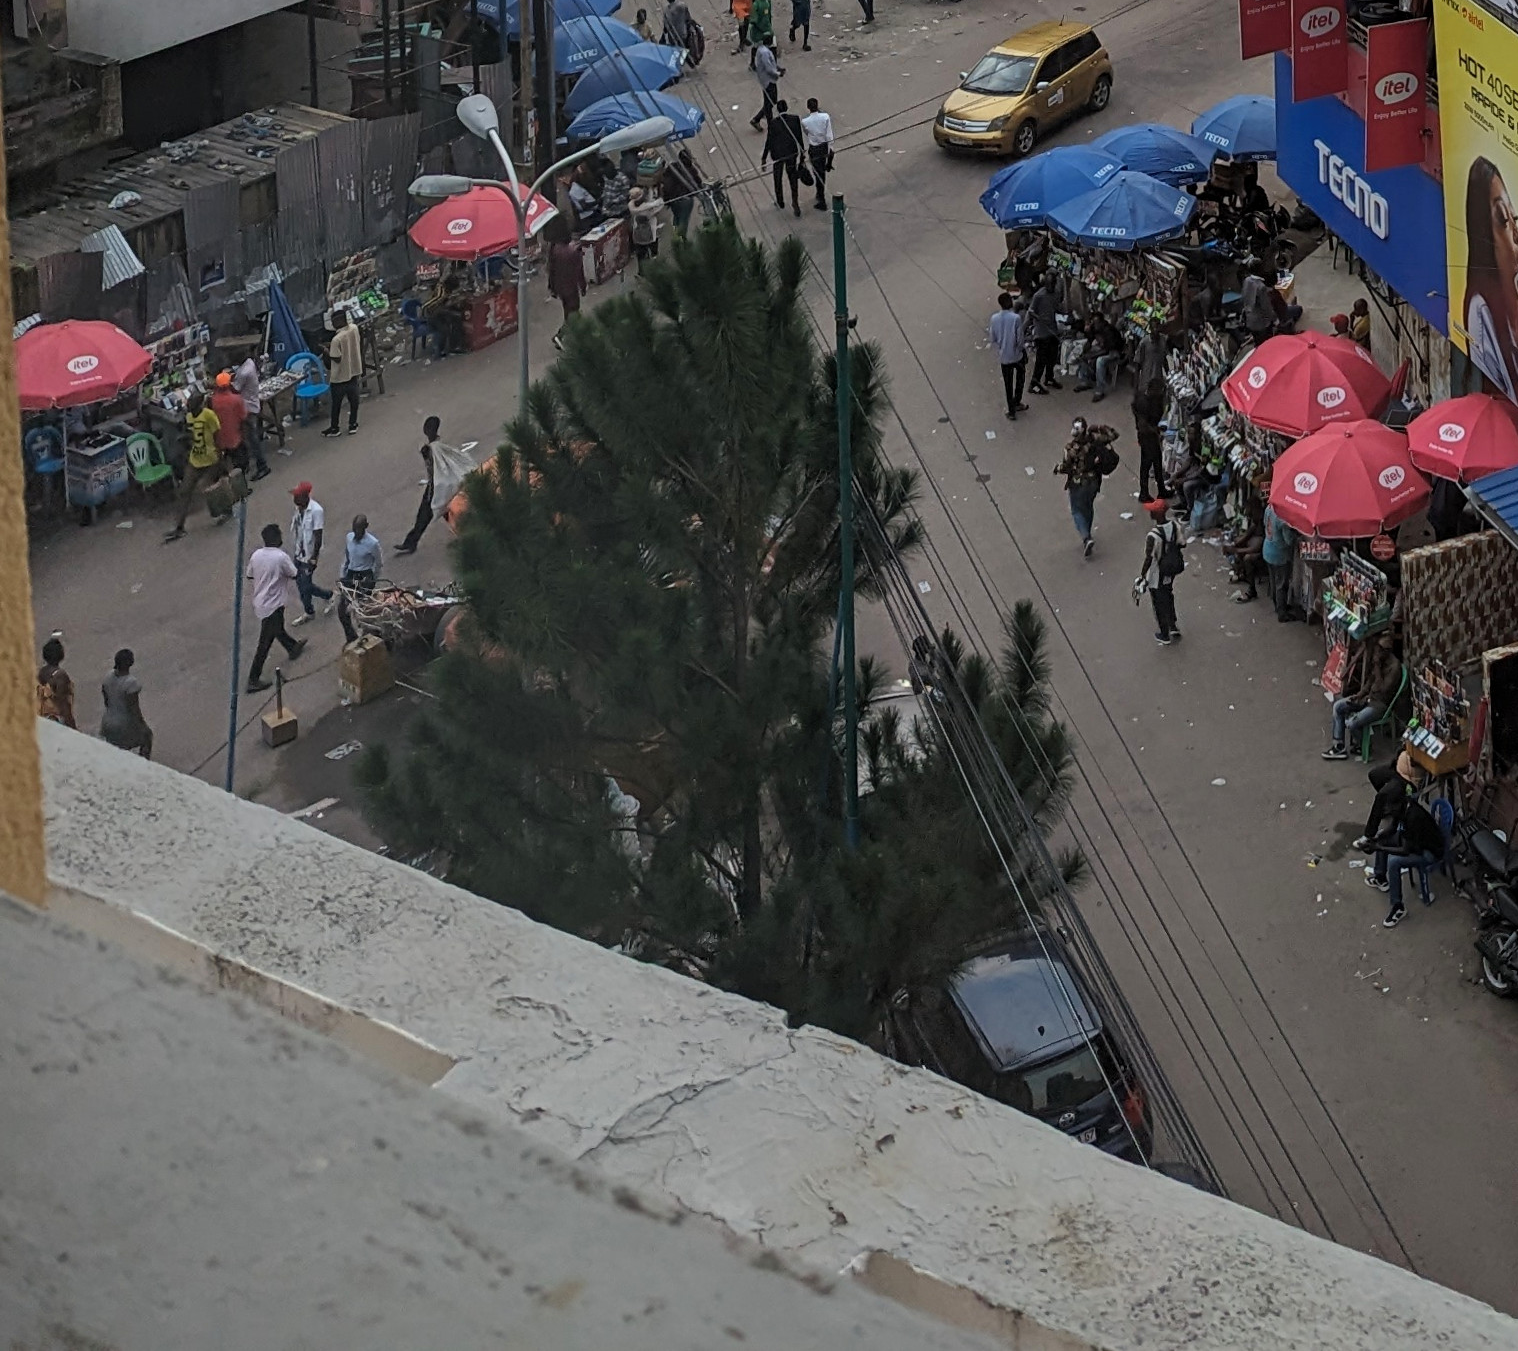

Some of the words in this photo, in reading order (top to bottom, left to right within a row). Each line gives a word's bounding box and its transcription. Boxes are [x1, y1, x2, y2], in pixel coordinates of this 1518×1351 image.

[1307, 10, 1333, 31] itel
[1468, 11, 1484, 32] airtel
[1458, 47, 1486, 84] HOT
[1487, 72, 1503, 99] 40
[1383, 77, 1410, 97] itel
[1374, 112, 1390, 120] Enjoy
[1470, 86, 1506, 125] RAPIDE
[1507, 113, 1515, 130] &
[1204, 131, 1230, 147] TECNO
[1094, 163, 1115, 179] TECNO
[1314, 139, 1389, 240] TECNO
[1014, 202, 1039, 212] TECNO
[1174, 196, 1189, 216] TECNO
[1090, 226, 1126, 236] TECNO
[73, 357, 93, 371] itel
[1323, 390, 1341, 403] itel
[1442, 426, 1461, 439] itel
[1298, 476, 1315, 490] itel
[1384, 468, 1403, 484] itel
